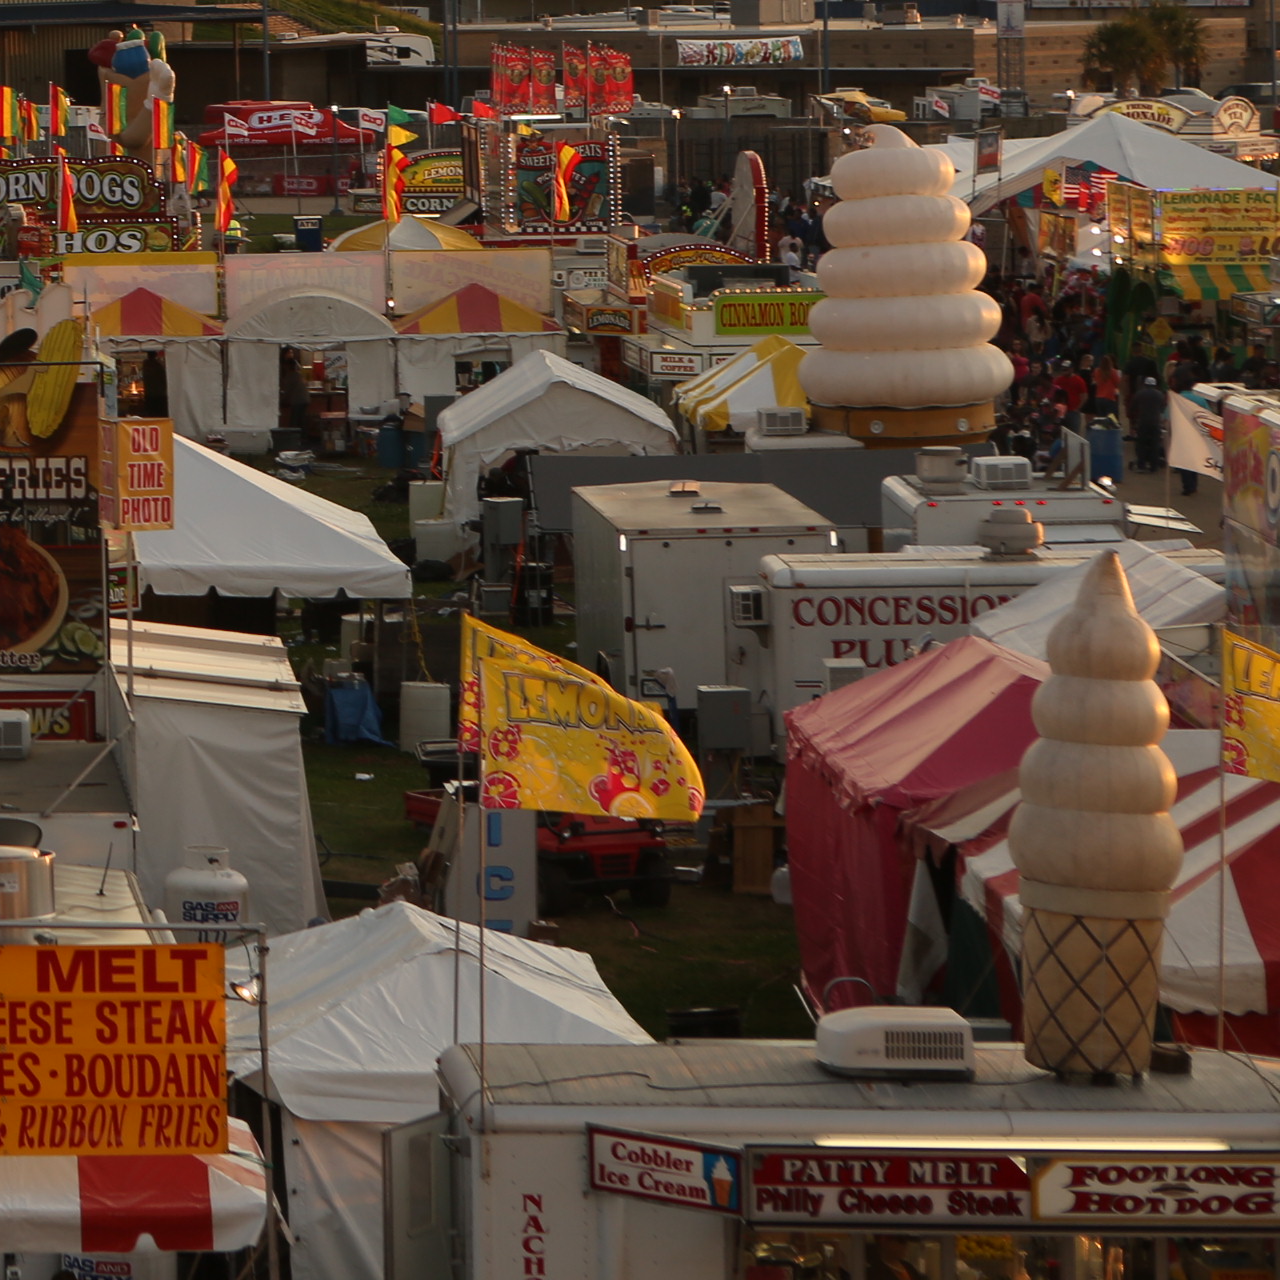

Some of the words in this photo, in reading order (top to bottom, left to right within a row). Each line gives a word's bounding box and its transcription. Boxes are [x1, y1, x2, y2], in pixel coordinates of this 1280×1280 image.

[520, 155, 556, 167] SWEETS
[406, 198, 454, 211] CORN
[1164, 192, 1240, 205] LEMONADE
[590, 312, 630, 330] LEMONADE
[720, 302, 785, 327] CINNAMON
[660, 356, 684, 364] MILK
[131, 426, 159, 454] OLD
[127, 461, 165, 490] TIME
[121, 496, 172, 524] PHOTO
[182, 901, 216, 912] GAS
[216, 901, 238, 911] AND
[182, 912, 239, 923] SUPPLY
[36, 948, 209, 994] MELT
[95, 999, 219, 1045] STEAK
[17, 1104, 127, 1149] RIBBON
[138, 1103, 220, 1149] FRIES
[611, 1140, 695, 1174] Cobbler
[598, 1164, 630, 1187] Ice
[637, 1170, 708, 1202] Cream
[782, 1159, 889, 1184] PATTY
[908, 1160, 999, 1186] MELT
[1063, 1165, 1168, 1189] FOOT
[1173, 1165, 1278, 1189] LONG
[756, 1187, 824, 1218] Philly
[837, 1188, 934, 1216] Cheese
[947, 1189, 1024, 1217] Steak
[1063, 1189, 1167, 1215] HOT
[1175, 1190, 1278, 1215] DOG
[522, 1193, 546, 1280] NACH
